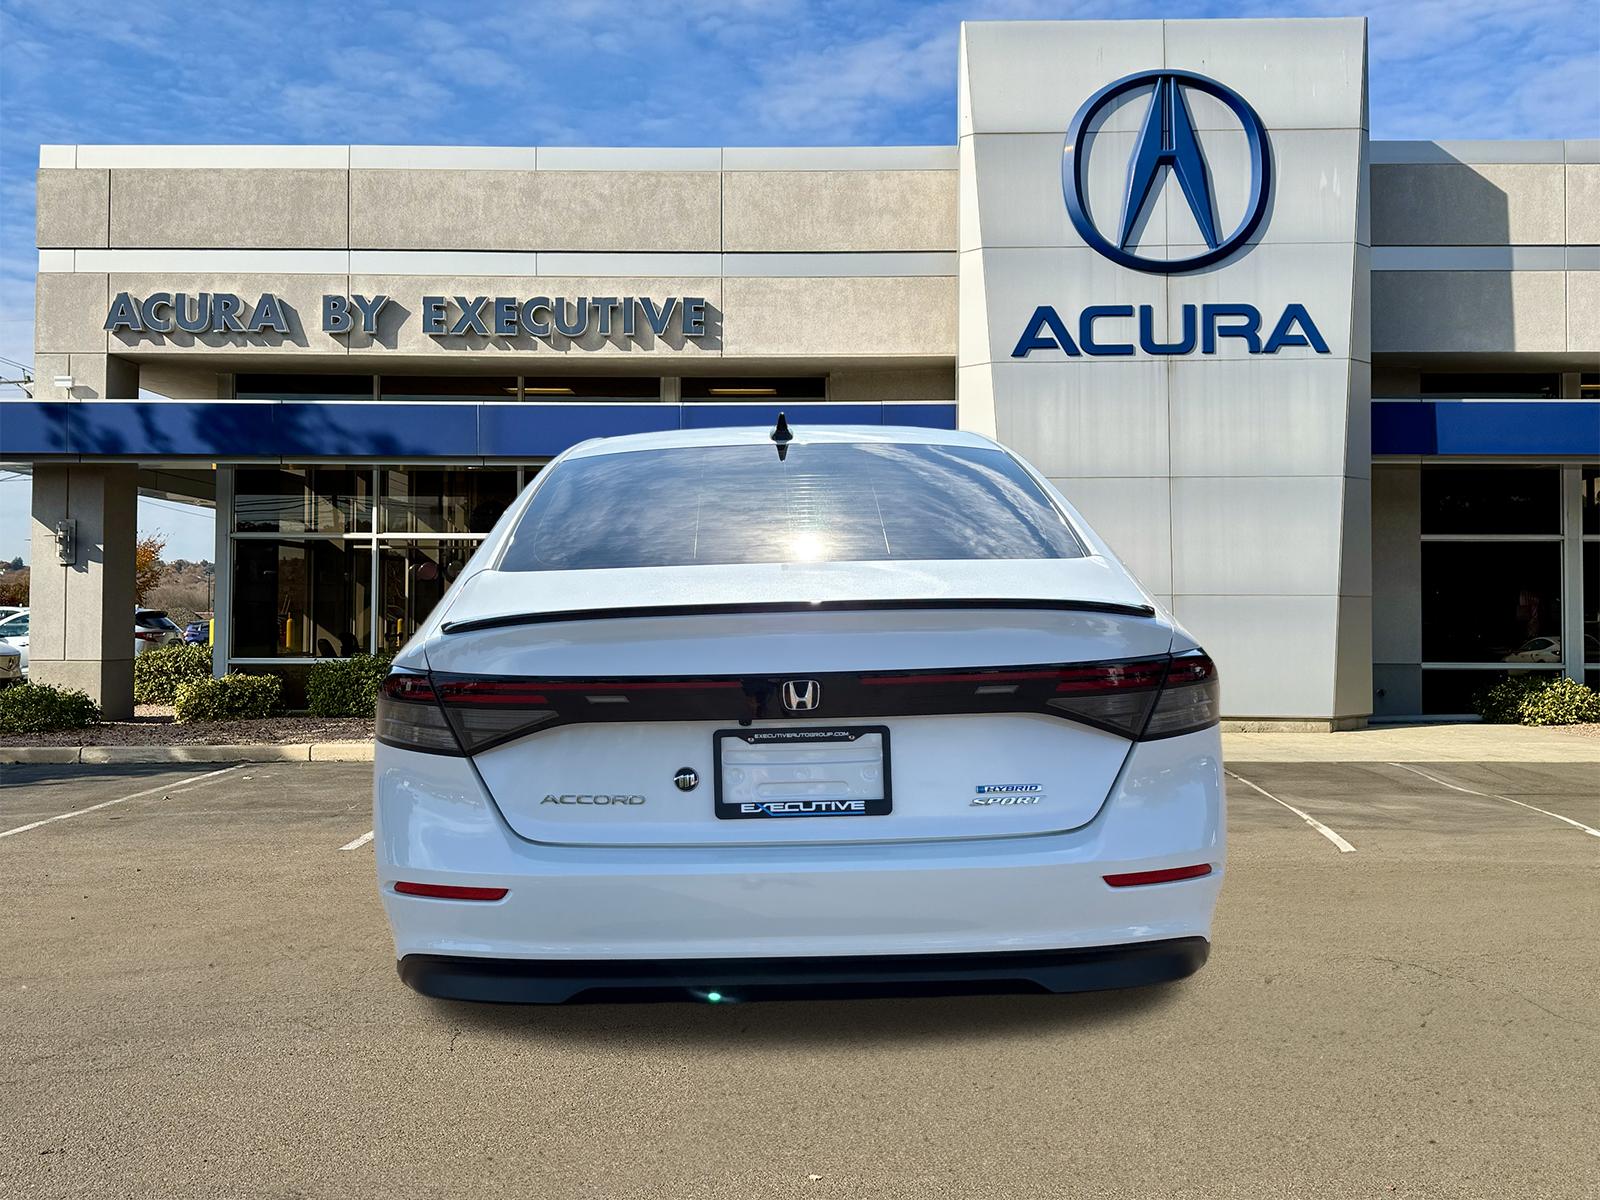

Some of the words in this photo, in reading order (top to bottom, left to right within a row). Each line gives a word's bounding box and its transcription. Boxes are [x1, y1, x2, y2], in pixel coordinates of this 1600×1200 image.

[102, 291, 291, 334] ACURA
[321, 294, 391, 335] BY
[421, 295, 706, 337] EXECUTIVE
[1010, 303, 1332, 357] ACURA
[985, 784, 1041, 793] HYBRID
[540, 794, 647, 806] ACCORD
[971, 796, 1043, 806] SPORT
[740, 801, 866, 814] EXECUTIVE
